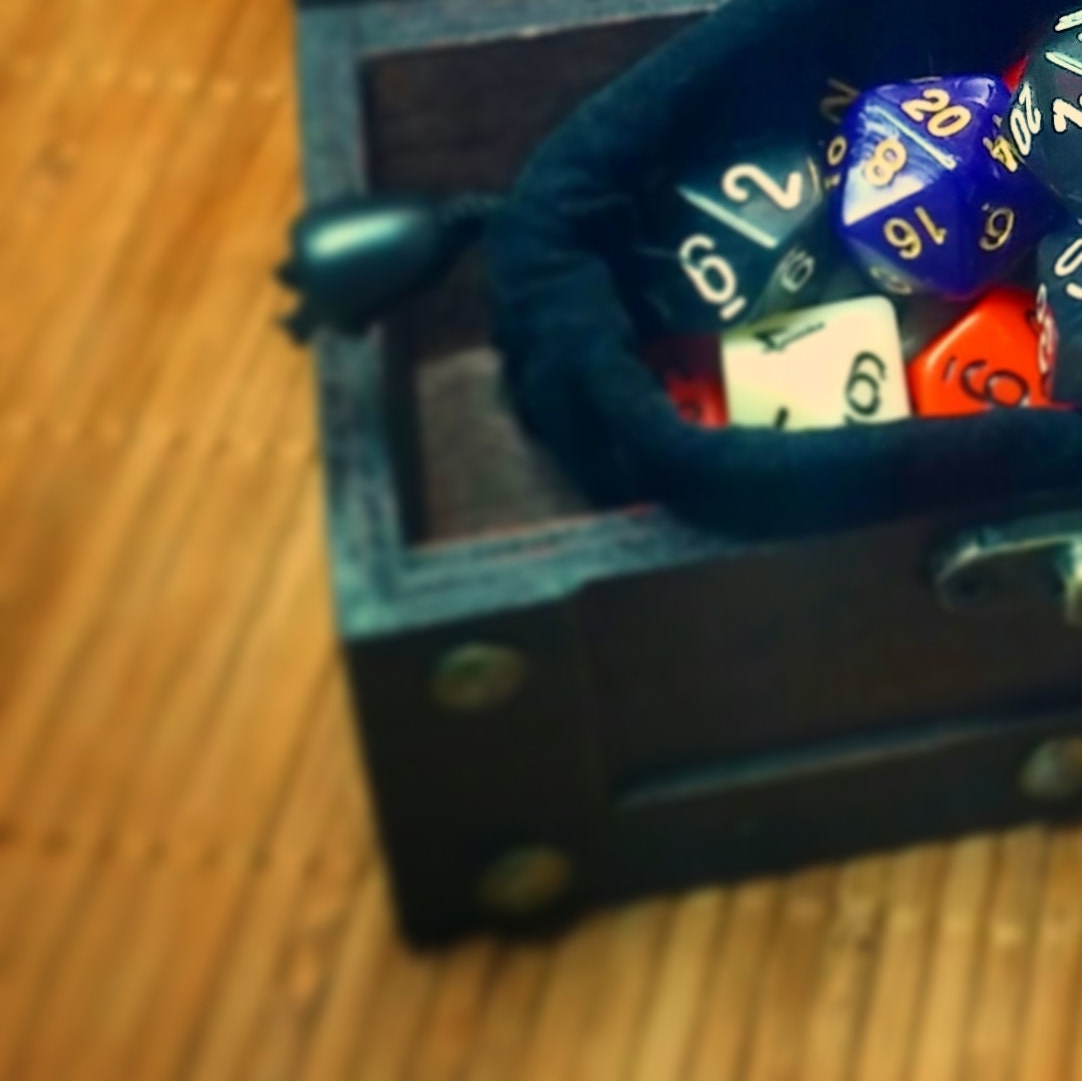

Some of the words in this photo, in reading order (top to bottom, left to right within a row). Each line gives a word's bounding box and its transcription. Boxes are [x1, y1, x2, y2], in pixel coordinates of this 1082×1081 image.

[901, 88, 972, 138] 20
[722, 164, 803, 210] 2
[864, 136, 908, 188] 8
[883, 206, 947, 260] 16
